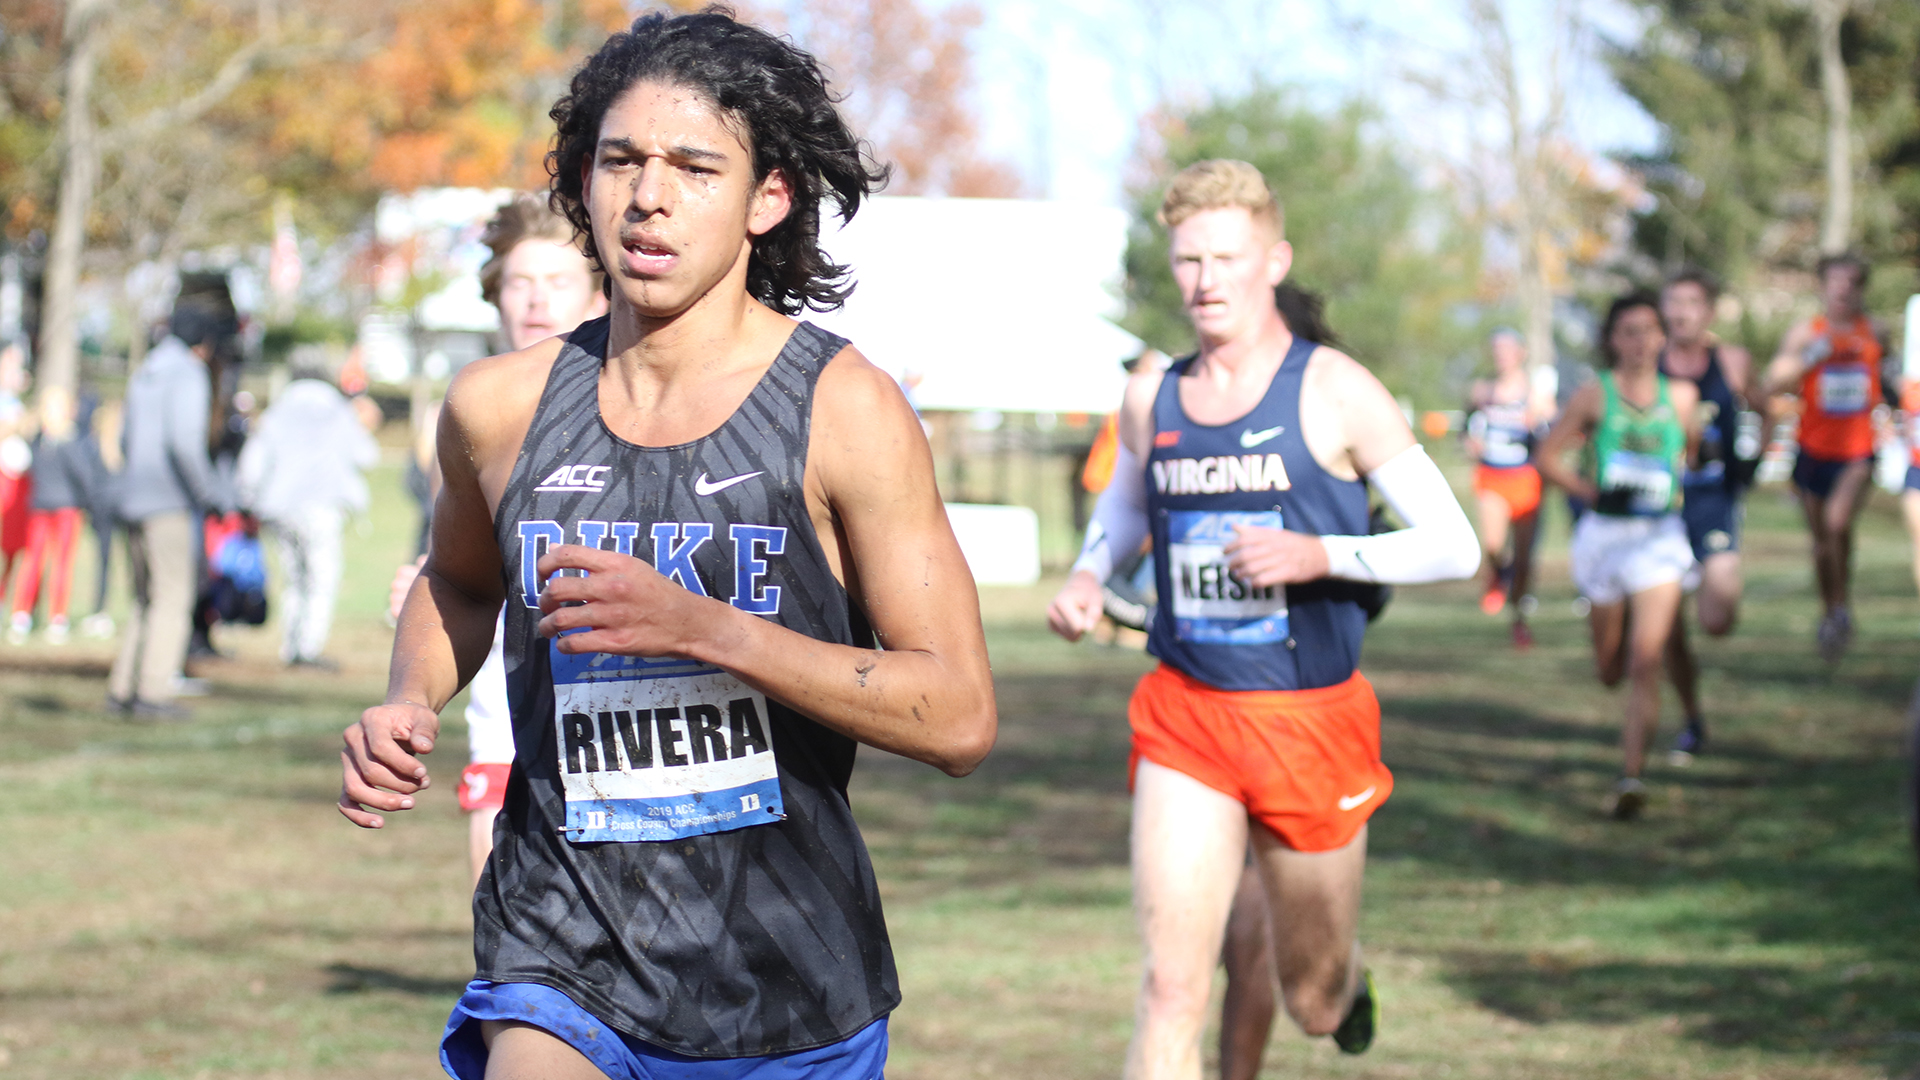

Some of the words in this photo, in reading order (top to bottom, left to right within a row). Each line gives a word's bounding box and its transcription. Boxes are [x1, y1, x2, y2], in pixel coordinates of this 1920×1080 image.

[535, 465, 612, 489] ACC
[1152, 454, 1292, 495] VIRGINIA
[563, 697, 768, 774] RIVERA
[611, 820, 635, 831] Cross
[670, 810, 737, 828] Championships
[647, 806, 673, 817] 2019
[675, 803, 696, 816] ACC
